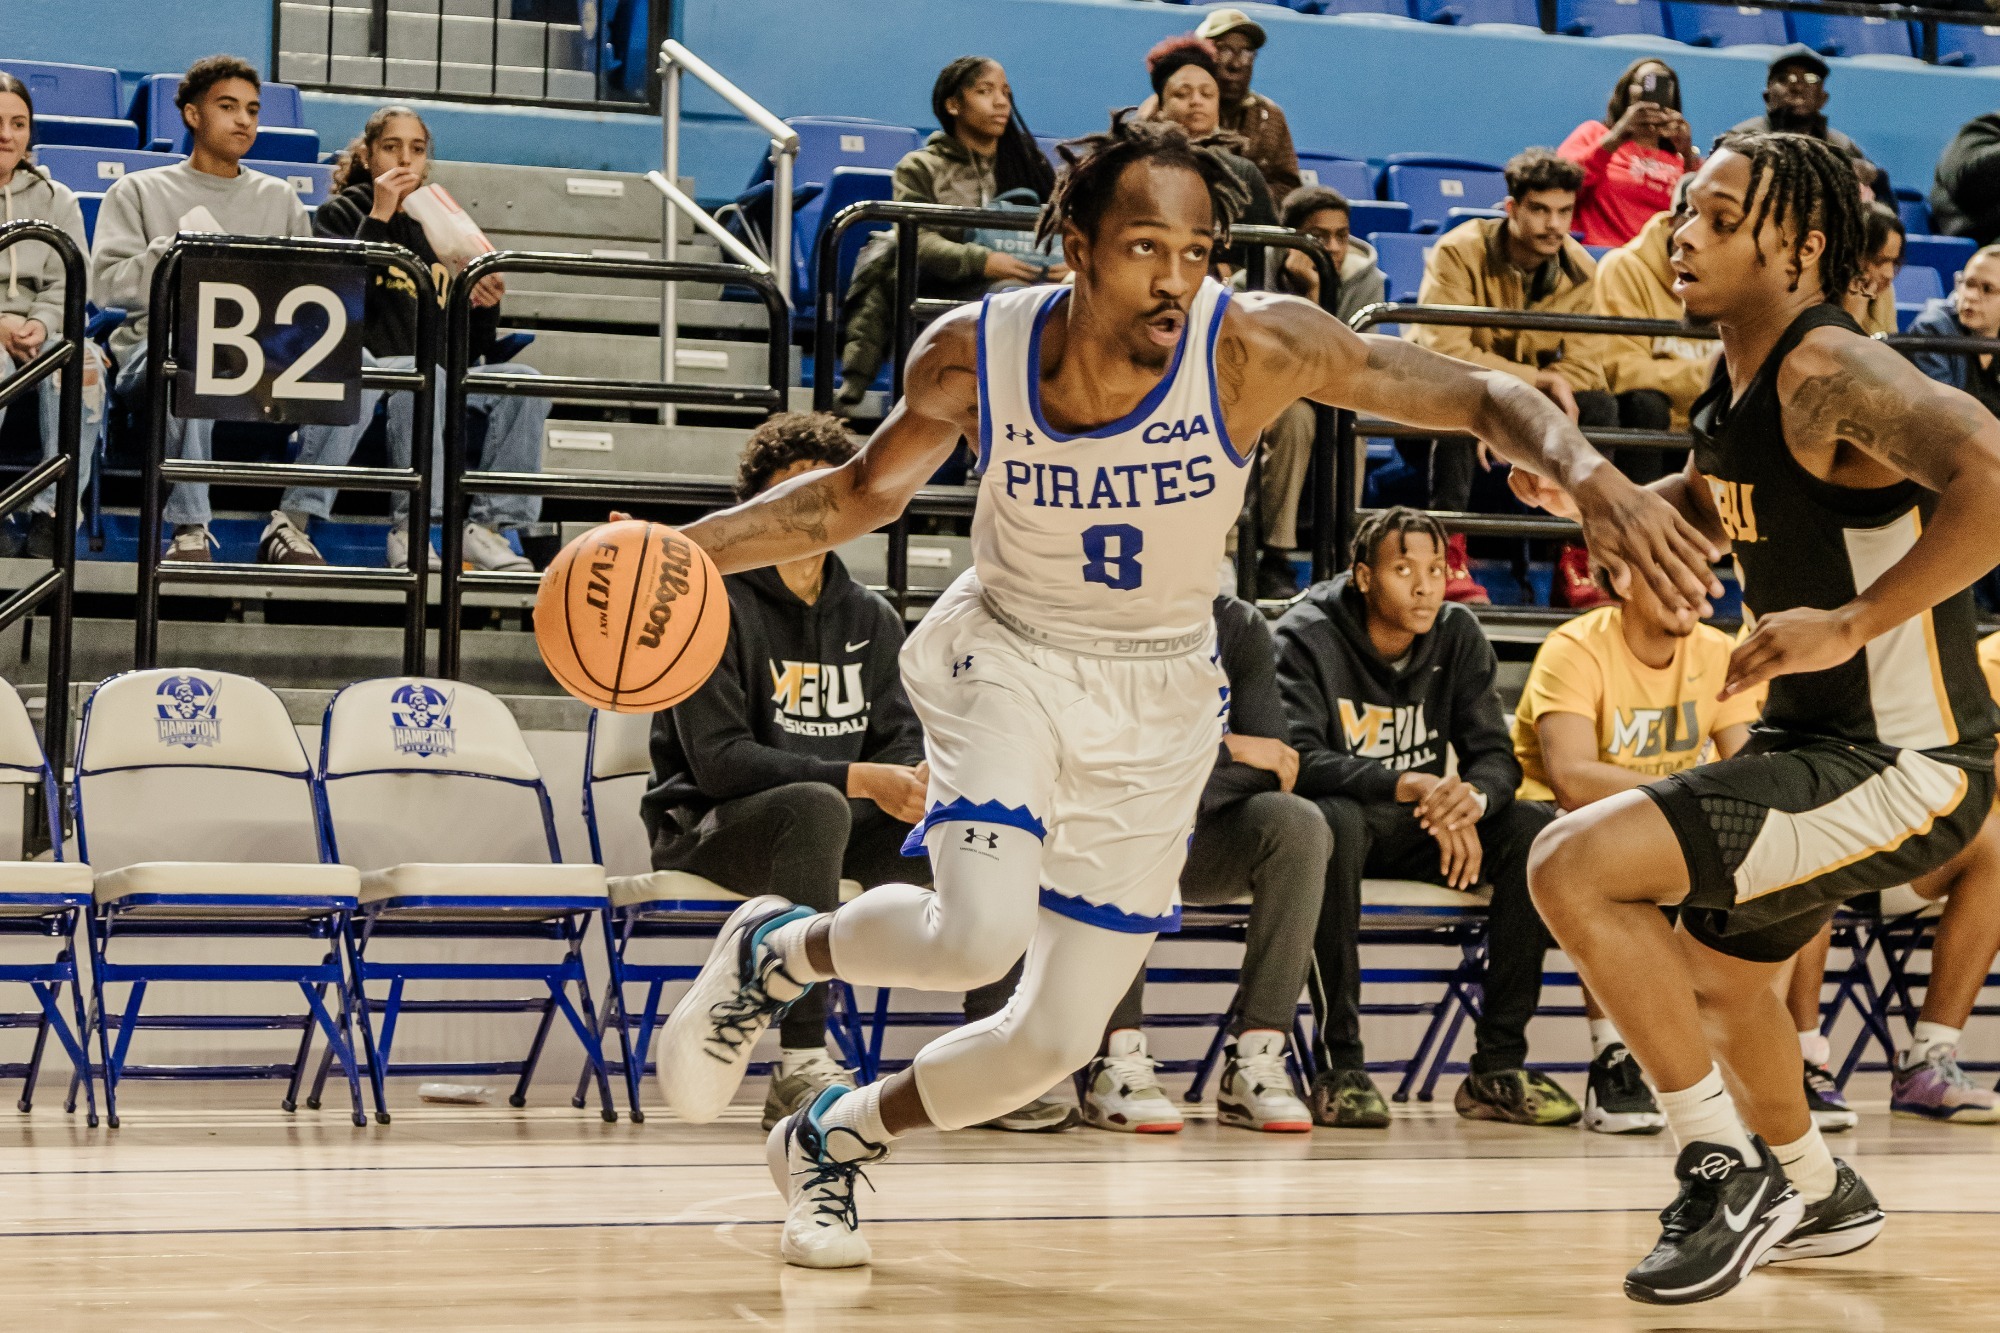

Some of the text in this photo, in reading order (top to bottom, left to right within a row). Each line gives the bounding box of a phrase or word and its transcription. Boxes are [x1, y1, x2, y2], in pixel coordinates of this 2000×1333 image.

[195, 281, 348, 401] B2
[1142, 414, 1210, 444] CAA
[1002, 454, 1216, 509] PIRATES
[1081, 523, 1144, 591] 8
[636, 536, 692, 649] Wilson
[1114, 624, 1208, 654] RMOUR
[159, 720, 219, 739] HAMPTON
[394, 728, 454, 750] HAMPTON
